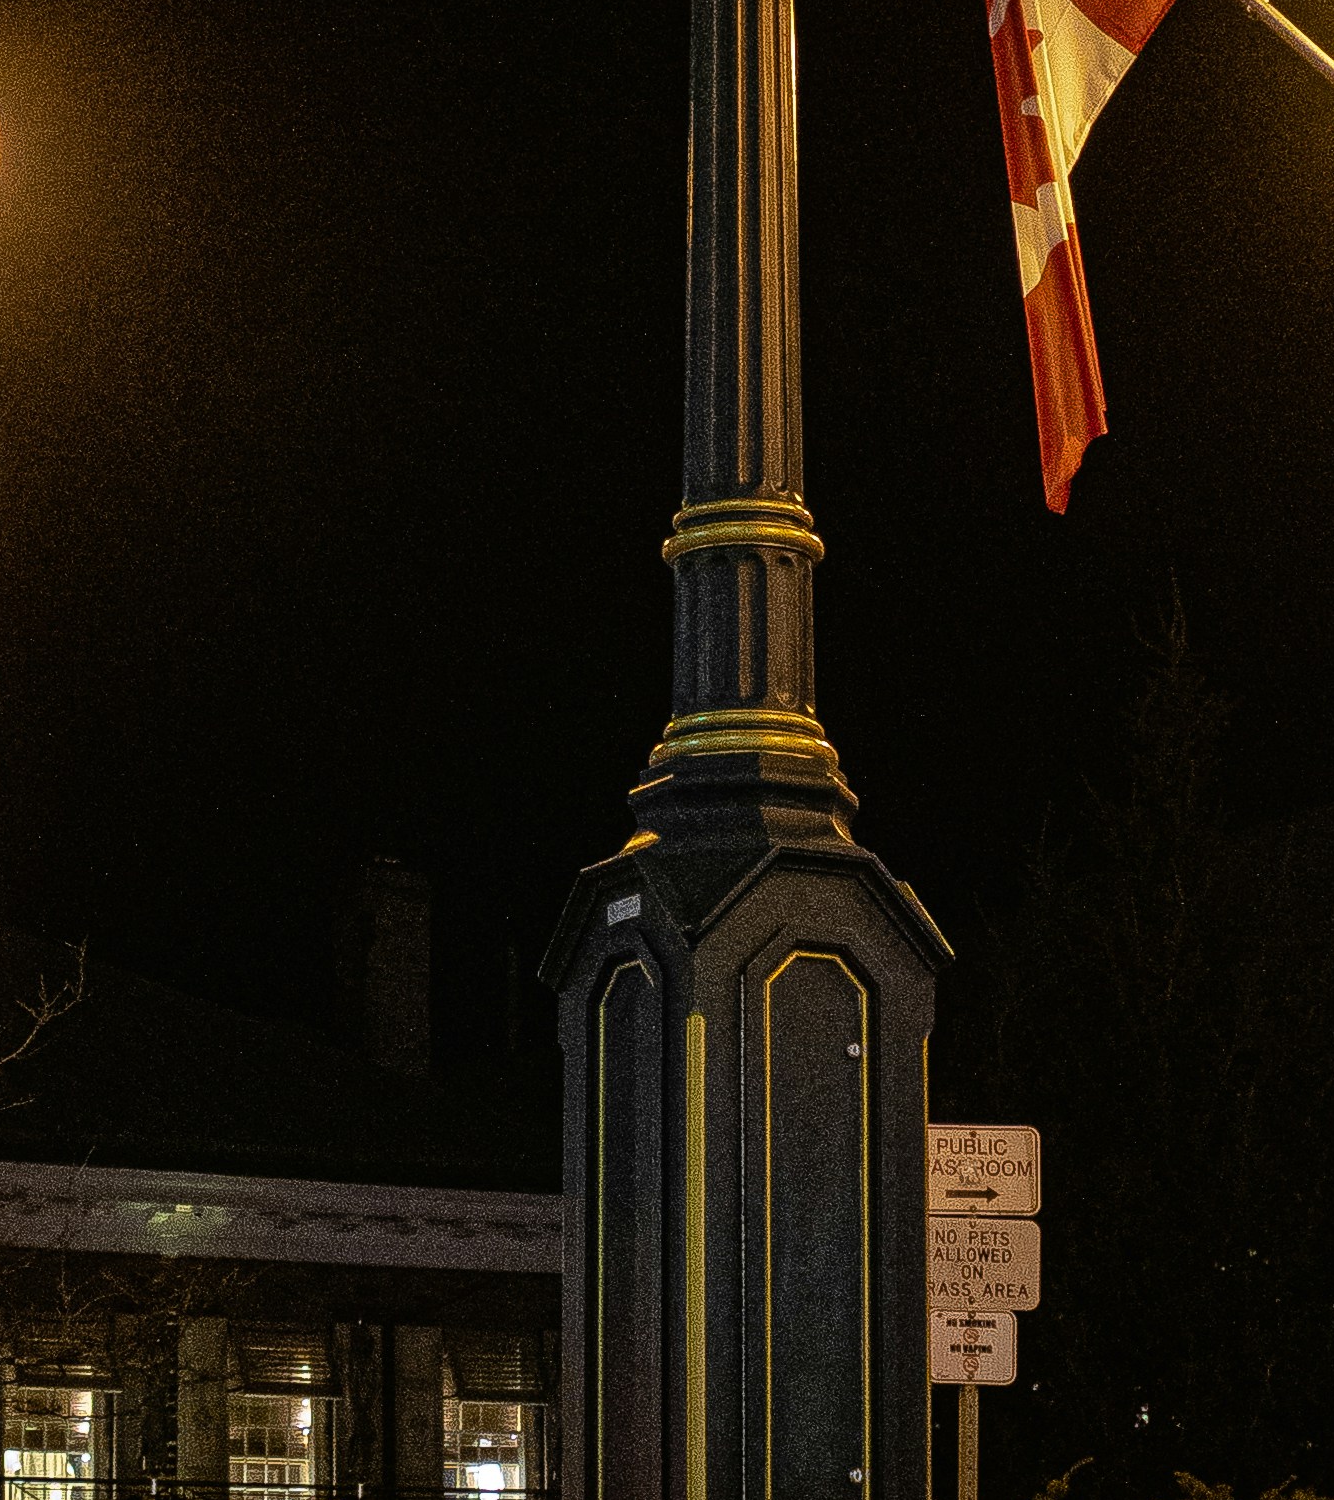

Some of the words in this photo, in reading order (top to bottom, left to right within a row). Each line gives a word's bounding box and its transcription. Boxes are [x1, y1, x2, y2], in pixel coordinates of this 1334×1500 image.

[936, 1138, 1008, 1155] PUBLIC
[935, 1229, 957, 1244] NO
[969, 1231, 1010, 1246] PETS
[932, 1247, 1012, 1263] ALLOWED
[961, 1265, 984, 1280] ON
[927, 1281, 971, 1297] RASS
[982, 1283, 1029, 1299] AREA
[946, 1318, 957, 1327] NO
[959, 1319, 997, 1328] SMOKING
[950, 1344, 961, 1353] NO
